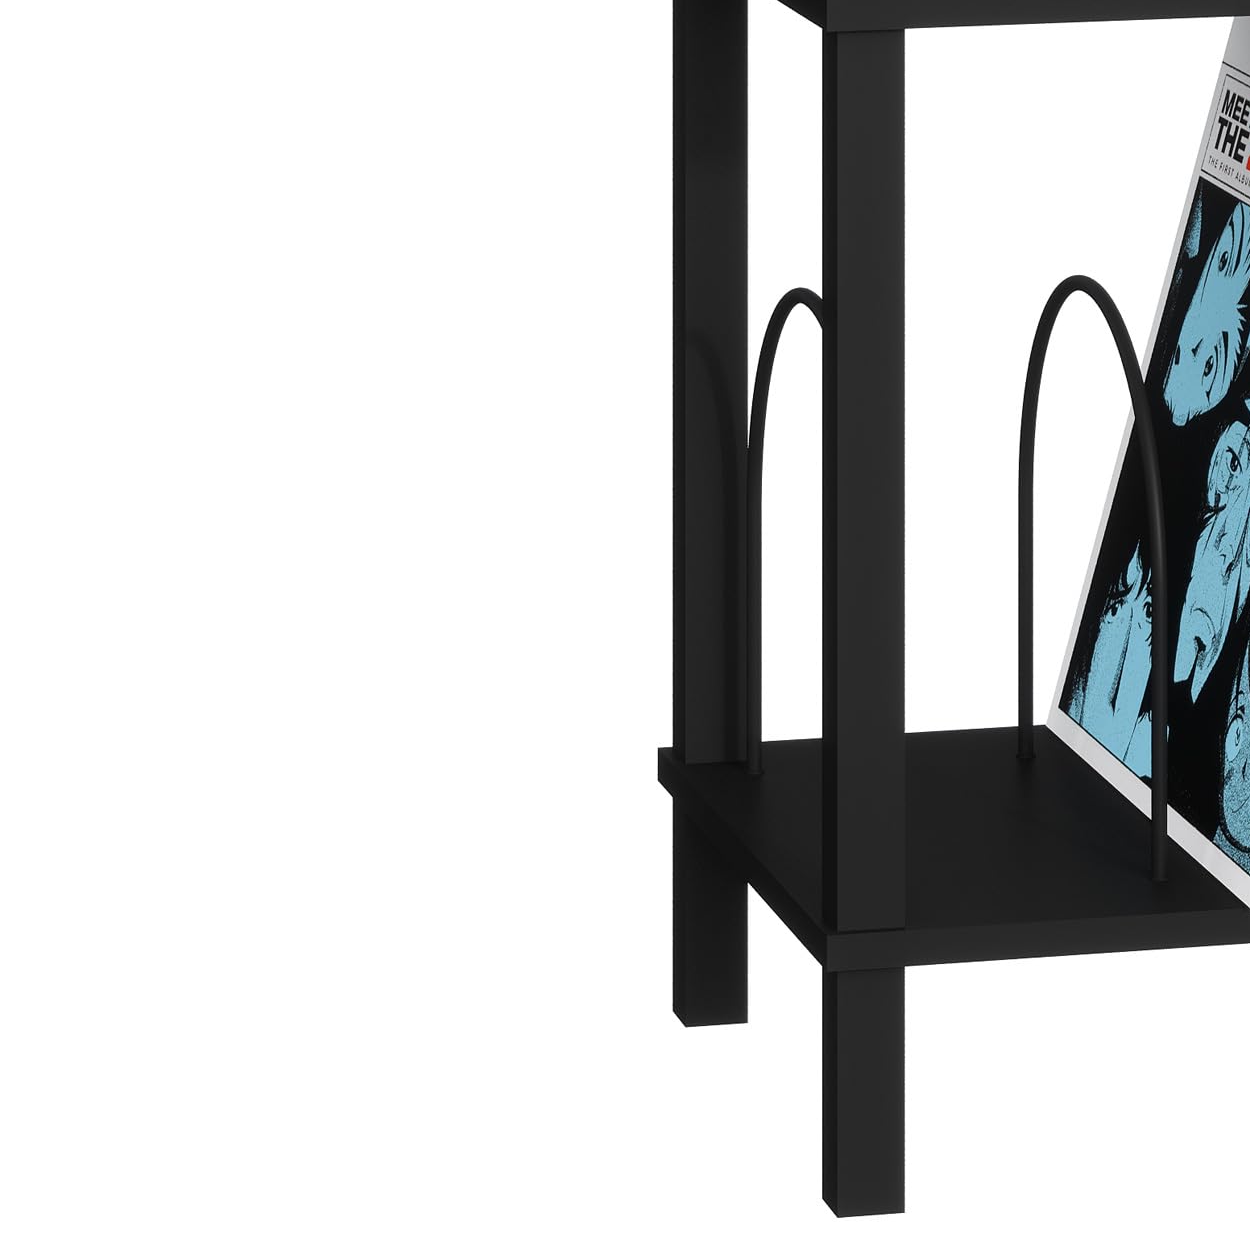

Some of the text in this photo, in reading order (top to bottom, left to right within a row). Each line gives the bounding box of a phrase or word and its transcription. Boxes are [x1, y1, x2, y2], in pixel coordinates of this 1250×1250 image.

[1214, 115, 1250, 164] THE
[1208, 155, 1219, 169] THE
[1219, 162, 1235, 177] FIRST
